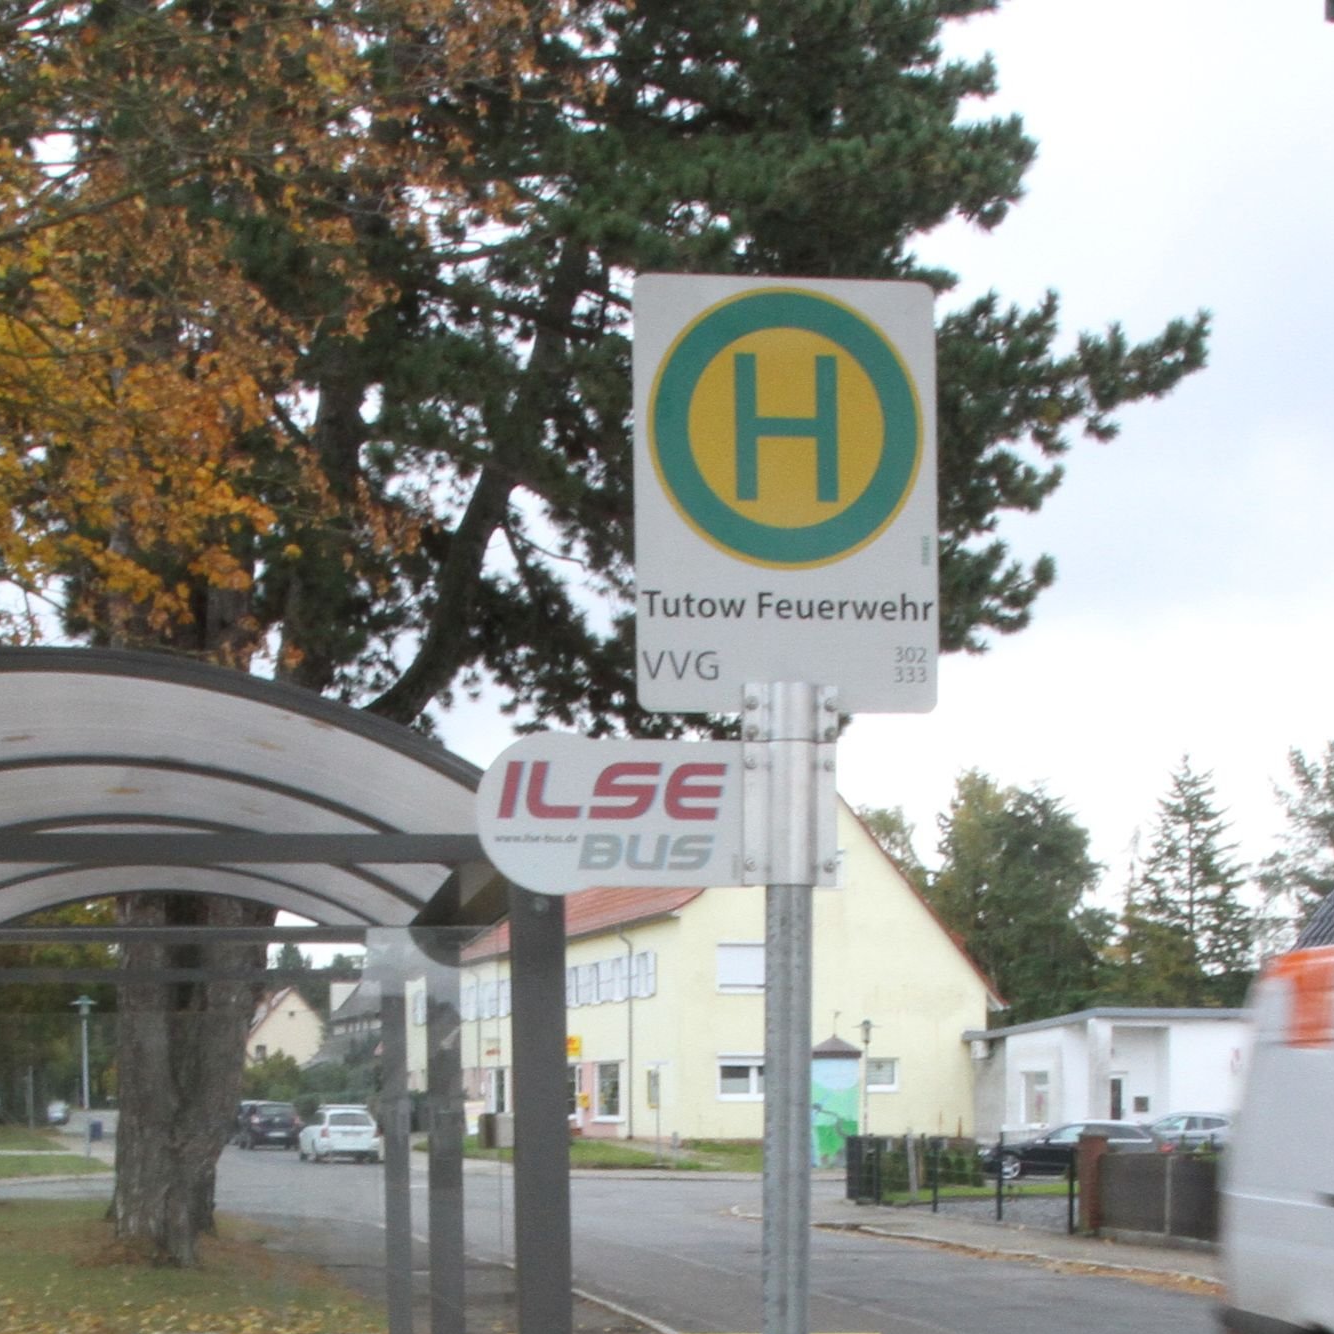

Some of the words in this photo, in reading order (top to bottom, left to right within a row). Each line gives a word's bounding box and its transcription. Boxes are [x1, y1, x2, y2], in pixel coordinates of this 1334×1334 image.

[733, 352, 839, 504] H
[641, 590, 747, 619] Tutow
[757, 592, 934, 621] Feuerwehr
[642, 650, 720, 681] VVG
[893, 646, 928, 664] 302
[893, 666, 928, 684] 333
[496, 760, 729, 821] ILSE
[577, 833, 715, 871] BUS
